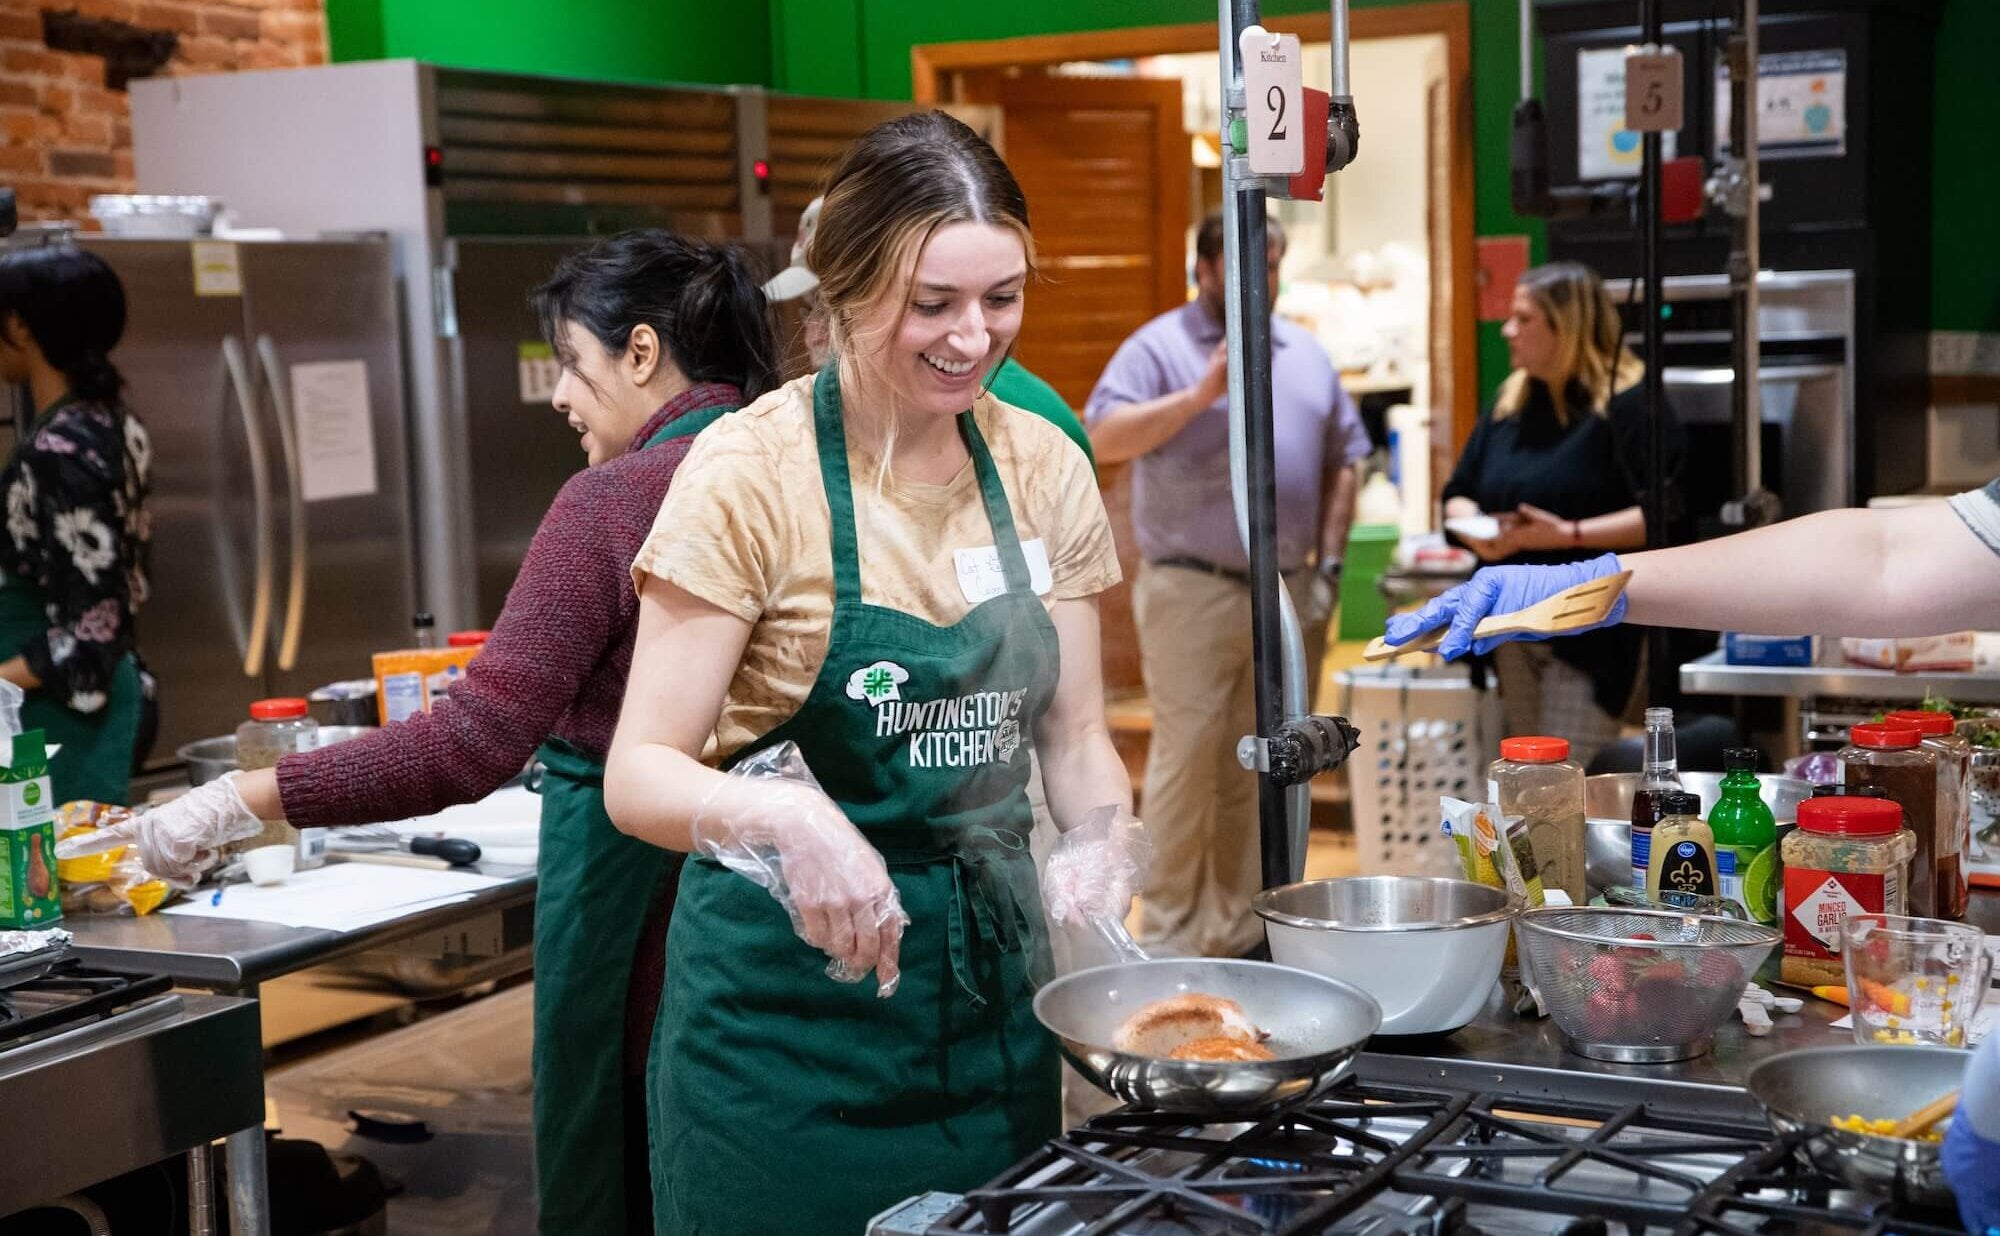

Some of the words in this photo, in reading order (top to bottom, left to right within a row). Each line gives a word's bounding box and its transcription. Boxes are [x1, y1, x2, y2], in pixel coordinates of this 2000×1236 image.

[1260, 51, 1286, 62] Kitchen
[1267, 85, 1286, 141] 2
[1642, 81, 1662, 114] 5
[876, 687, 1027, 737] HUNTINGTON'S
[910, 730, 998, 767] KITCHEN
[1818, 901, 1846, 913] MINCED
